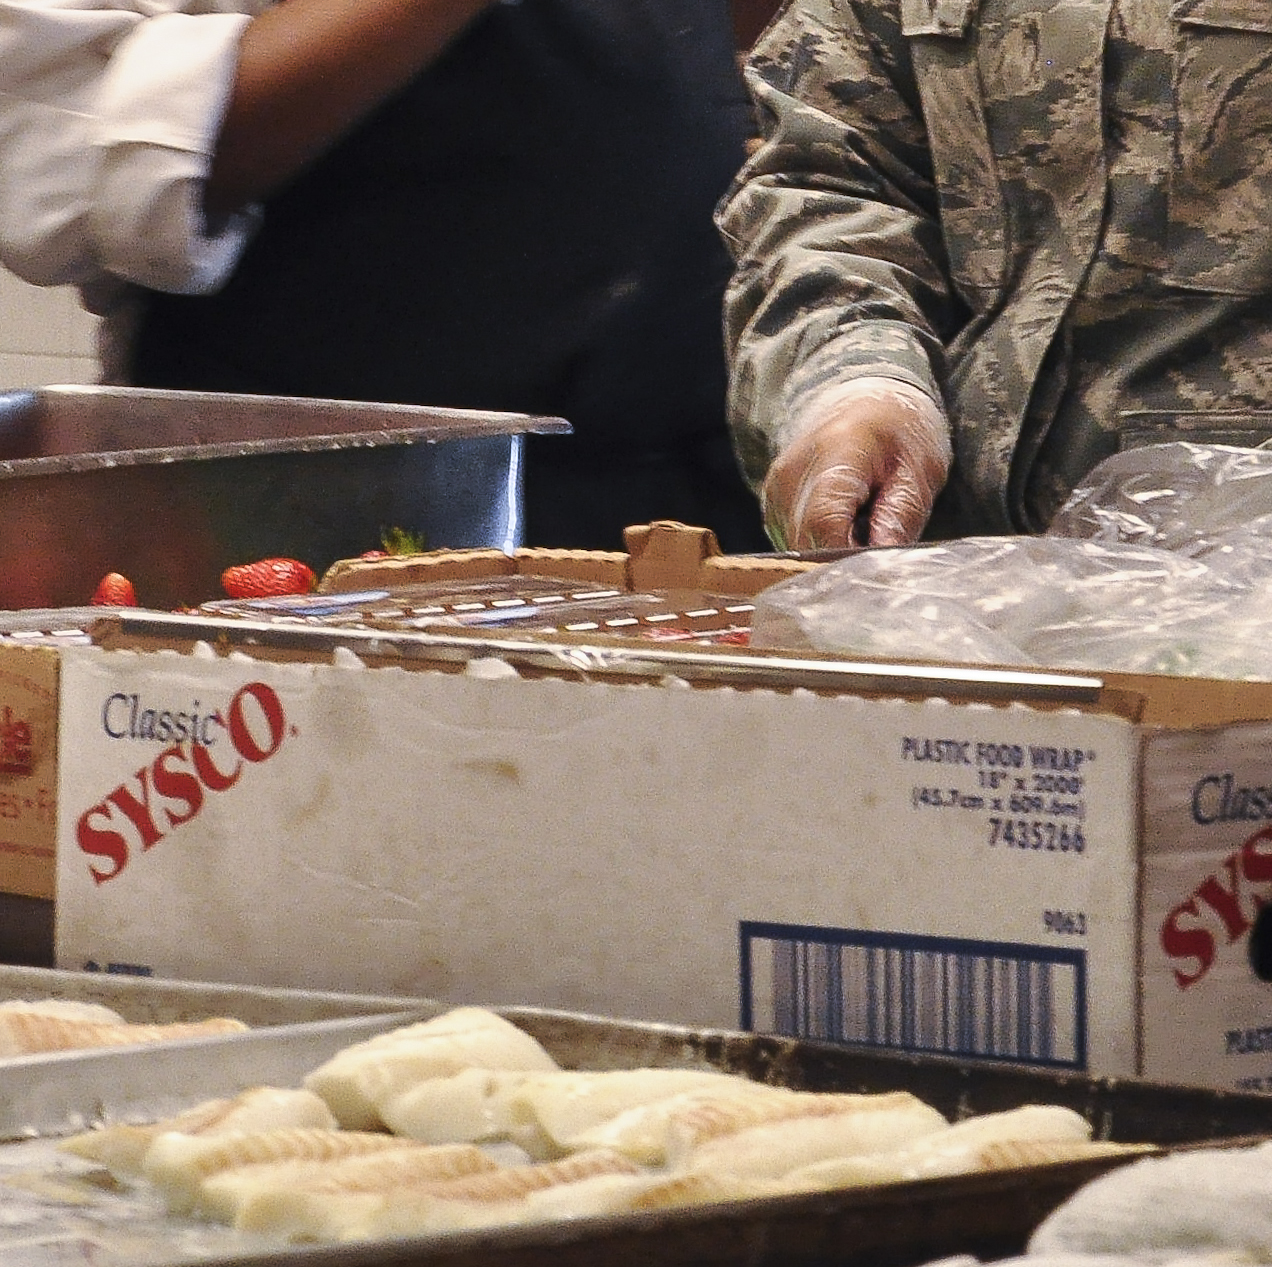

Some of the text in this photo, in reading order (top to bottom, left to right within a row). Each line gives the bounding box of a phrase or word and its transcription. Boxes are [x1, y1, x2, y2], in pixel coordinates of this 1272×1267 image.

[102, 692, 218, 746] Classic
[902, 737, 971, 766] PLASTIC
[977, 743, 1024, 768] FOOD
[75, 682, 286, 887] SYSCO
[912, 786, 984, 811] (45.7cm
[991, 797, 1003, 811] x
[1014, 777, 1026, 791] x
[988, 817, 1086, 853] 7435266
